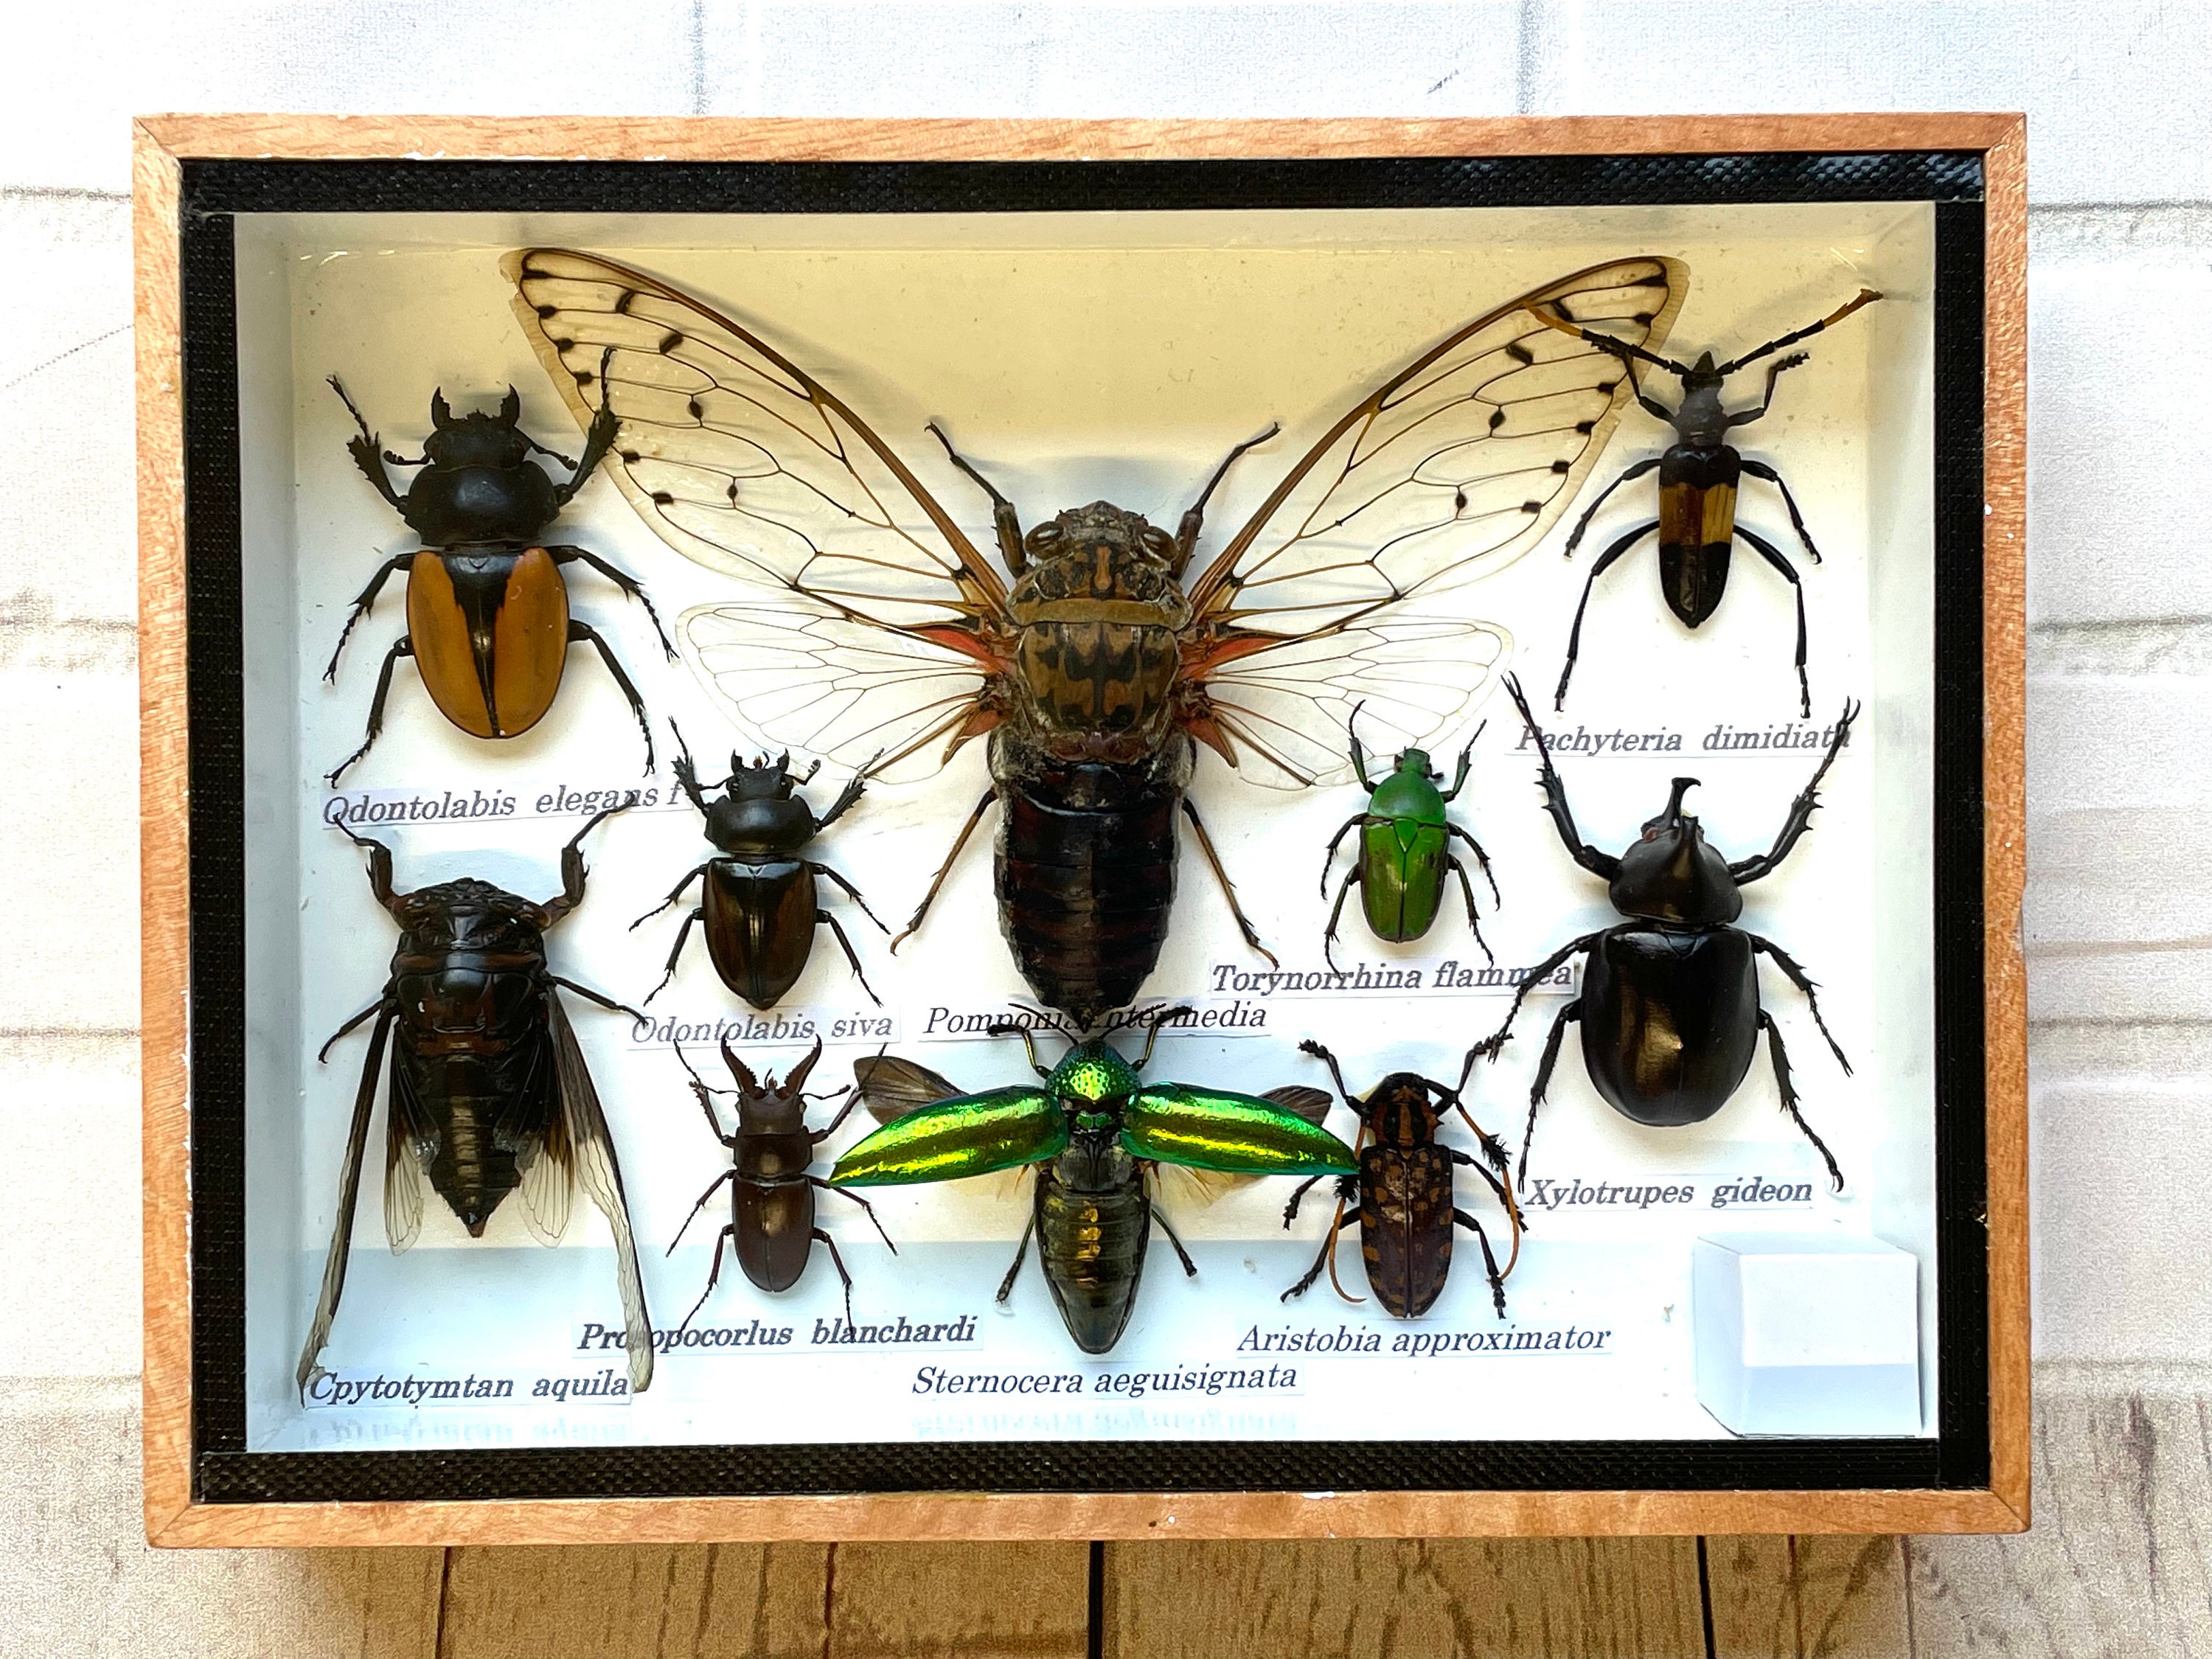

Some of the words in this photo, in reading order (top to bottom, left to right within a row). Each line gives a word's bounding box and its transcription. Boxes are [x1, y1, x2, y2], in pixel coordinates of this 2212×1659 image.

[1515, 724, 1682, 757] Pachyteria
[323, 788, 516, 825] Odontolabis
[535, 784, 658, 816] elegans
[1214, 961, 1421, 996] Torynorrhina
[631, 1013, 815, 1043] Odontolabis
[830, 1012, 893, 1037] siva
[1525, 1179, 1694, 1209] Xylotrupes
[1711, 1176, 1812, 1208] gideon
[577, 1320, 794, 1354] Proopocorlus
[810, 1315, 976, 1344] blanchardi
[1237, 1325, 1381, 1352] Aristobia
[1391, 1325, 1611, 1357] approximator
[310, 1372, 514, 1405] Cpytotymtan
[532, 1368, 628, 1402] aquila
[912, 1366, 1084, 1394] Sternocera
[1094, 1363, 1297, 1398] aeguisignata
